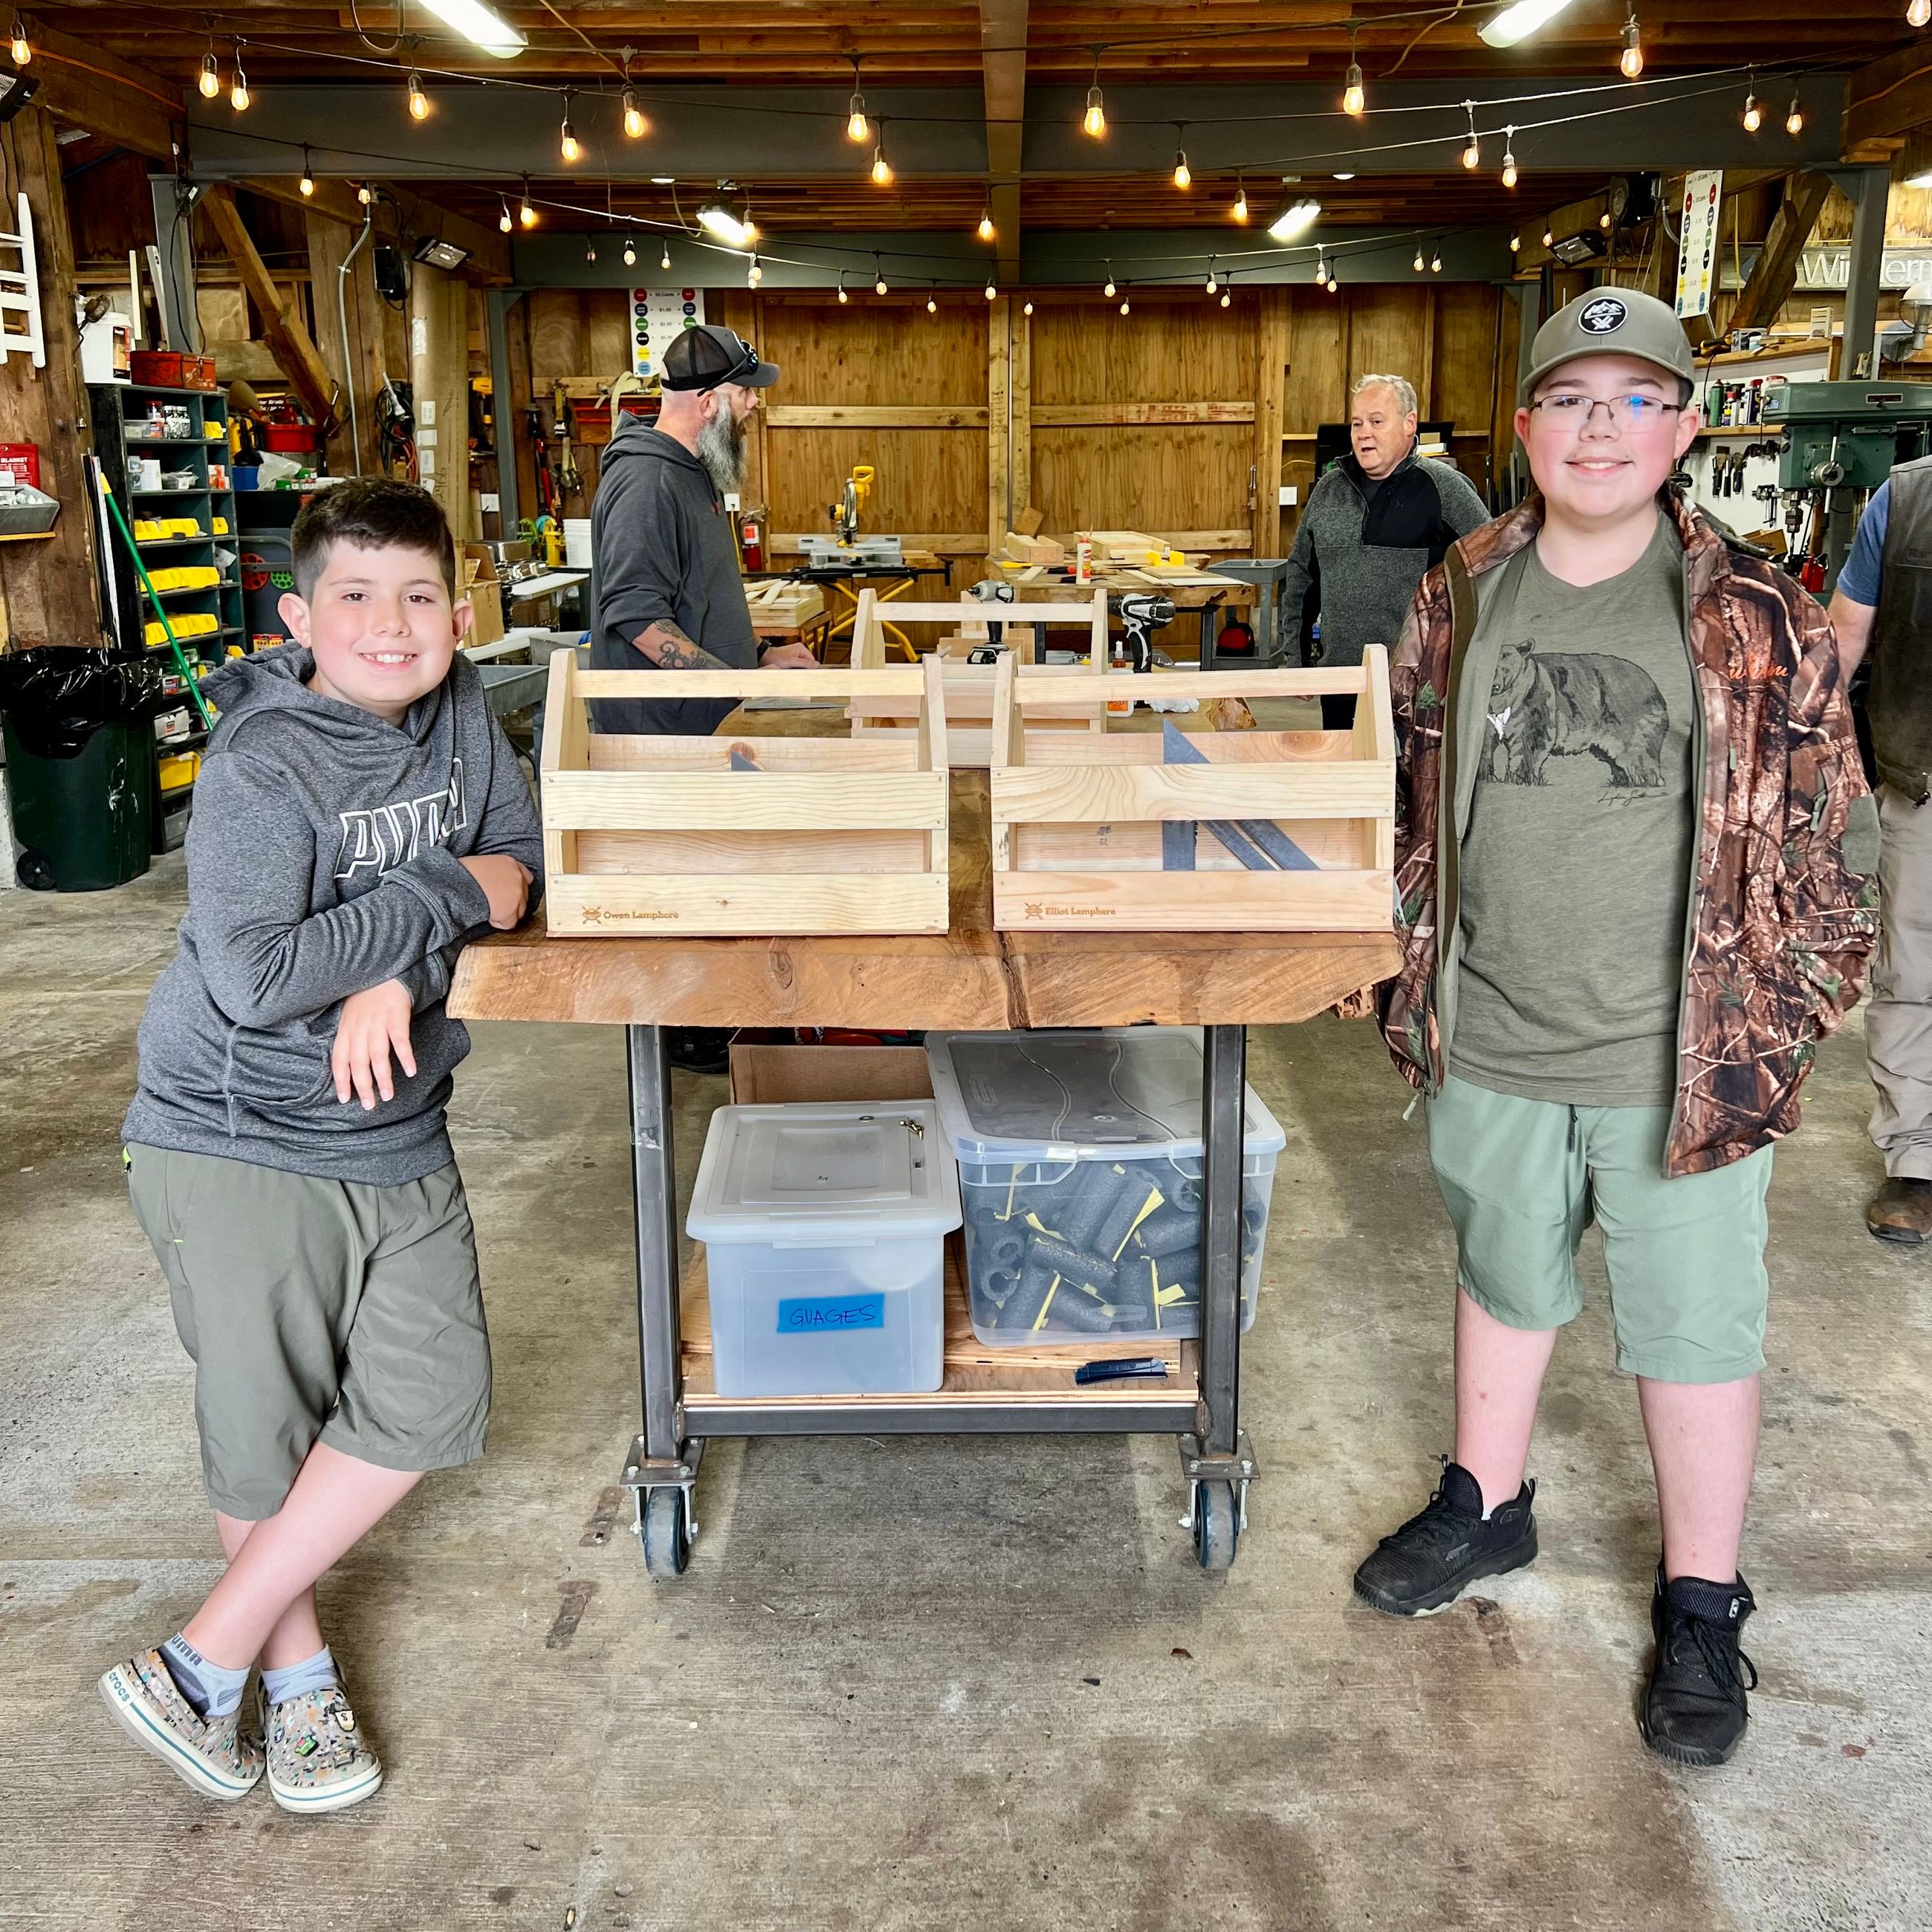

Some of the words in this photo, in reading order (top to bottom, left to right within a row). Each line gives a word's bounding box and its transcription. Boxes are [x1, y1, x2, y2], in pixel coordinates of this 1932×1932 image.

[603, 911, 631, 919] Owen
[632, 910, 679, 921] Lamphere
[1046, 907, 1069, 915] Elliot
[1071, 907, 1116, 918] Lamphere
[789, 1304, 876, 1326] GUAGES
[171, 1634, 203, 1667] UMA
[108, 1671, 131, 1702] crocs
